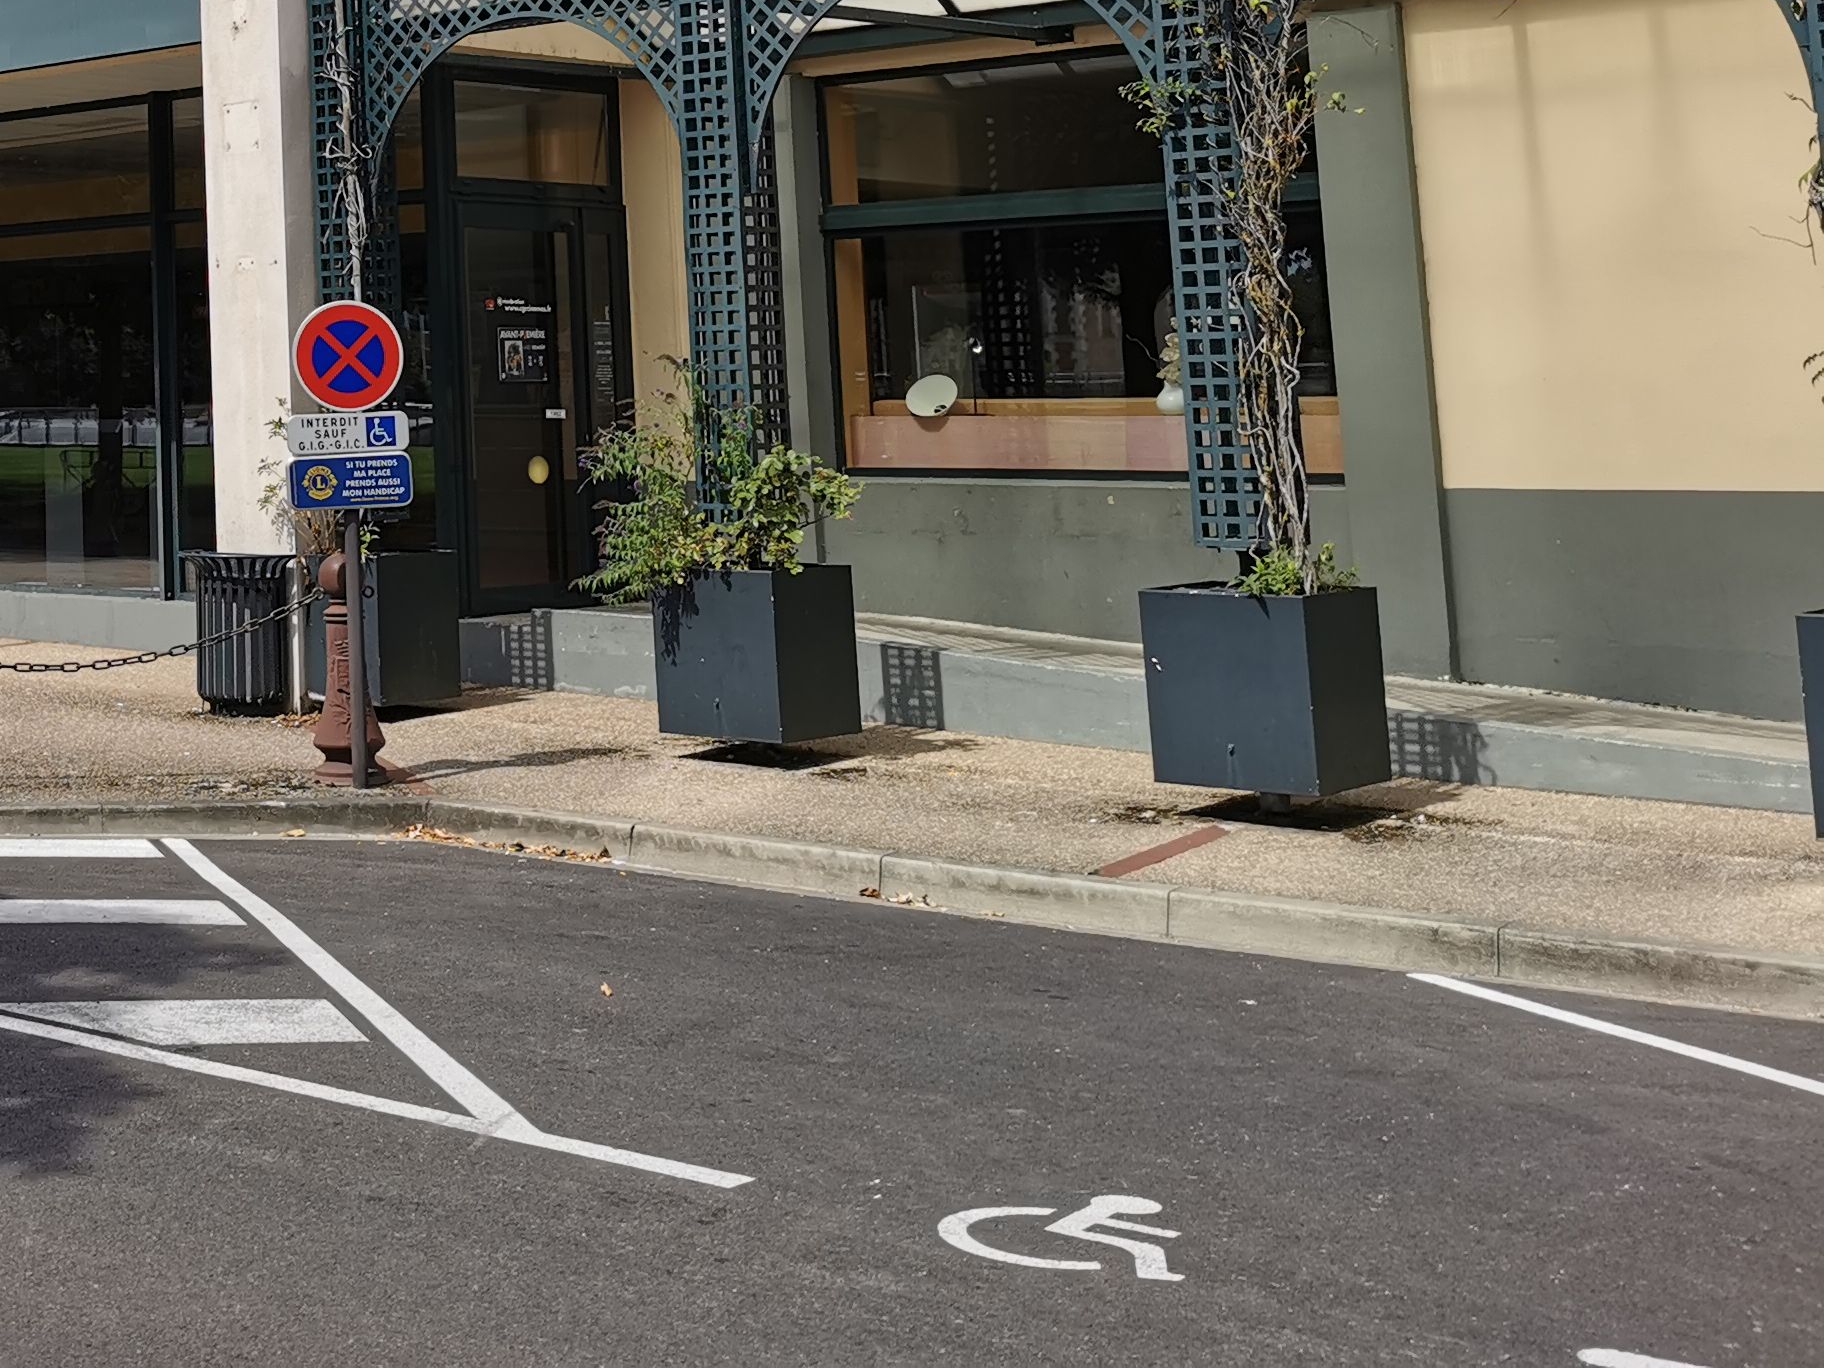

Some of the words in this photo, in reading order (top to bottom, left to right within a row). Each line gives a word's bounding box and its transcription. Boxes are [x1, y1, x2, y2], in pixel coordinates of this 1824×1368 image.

[301, 416, 358, 428] INTERDIT
[314, 428, 347, 439] SAUF
[346, 461, 354, 469] SI
[355, 460, 366, 468] TU
[367, 458, 398, 467] PRENDS
[353, 470, 367, 478] MA
[367, 468, 392, 477] PLACE
[316, 476, 326, 489] L
[346, 479, 376, 487] PRENDS
[377, 477, 401, 486] AUSSI
[342, 489, 363, 497] MON
[364, 486, 406, 496] HANDICAP
